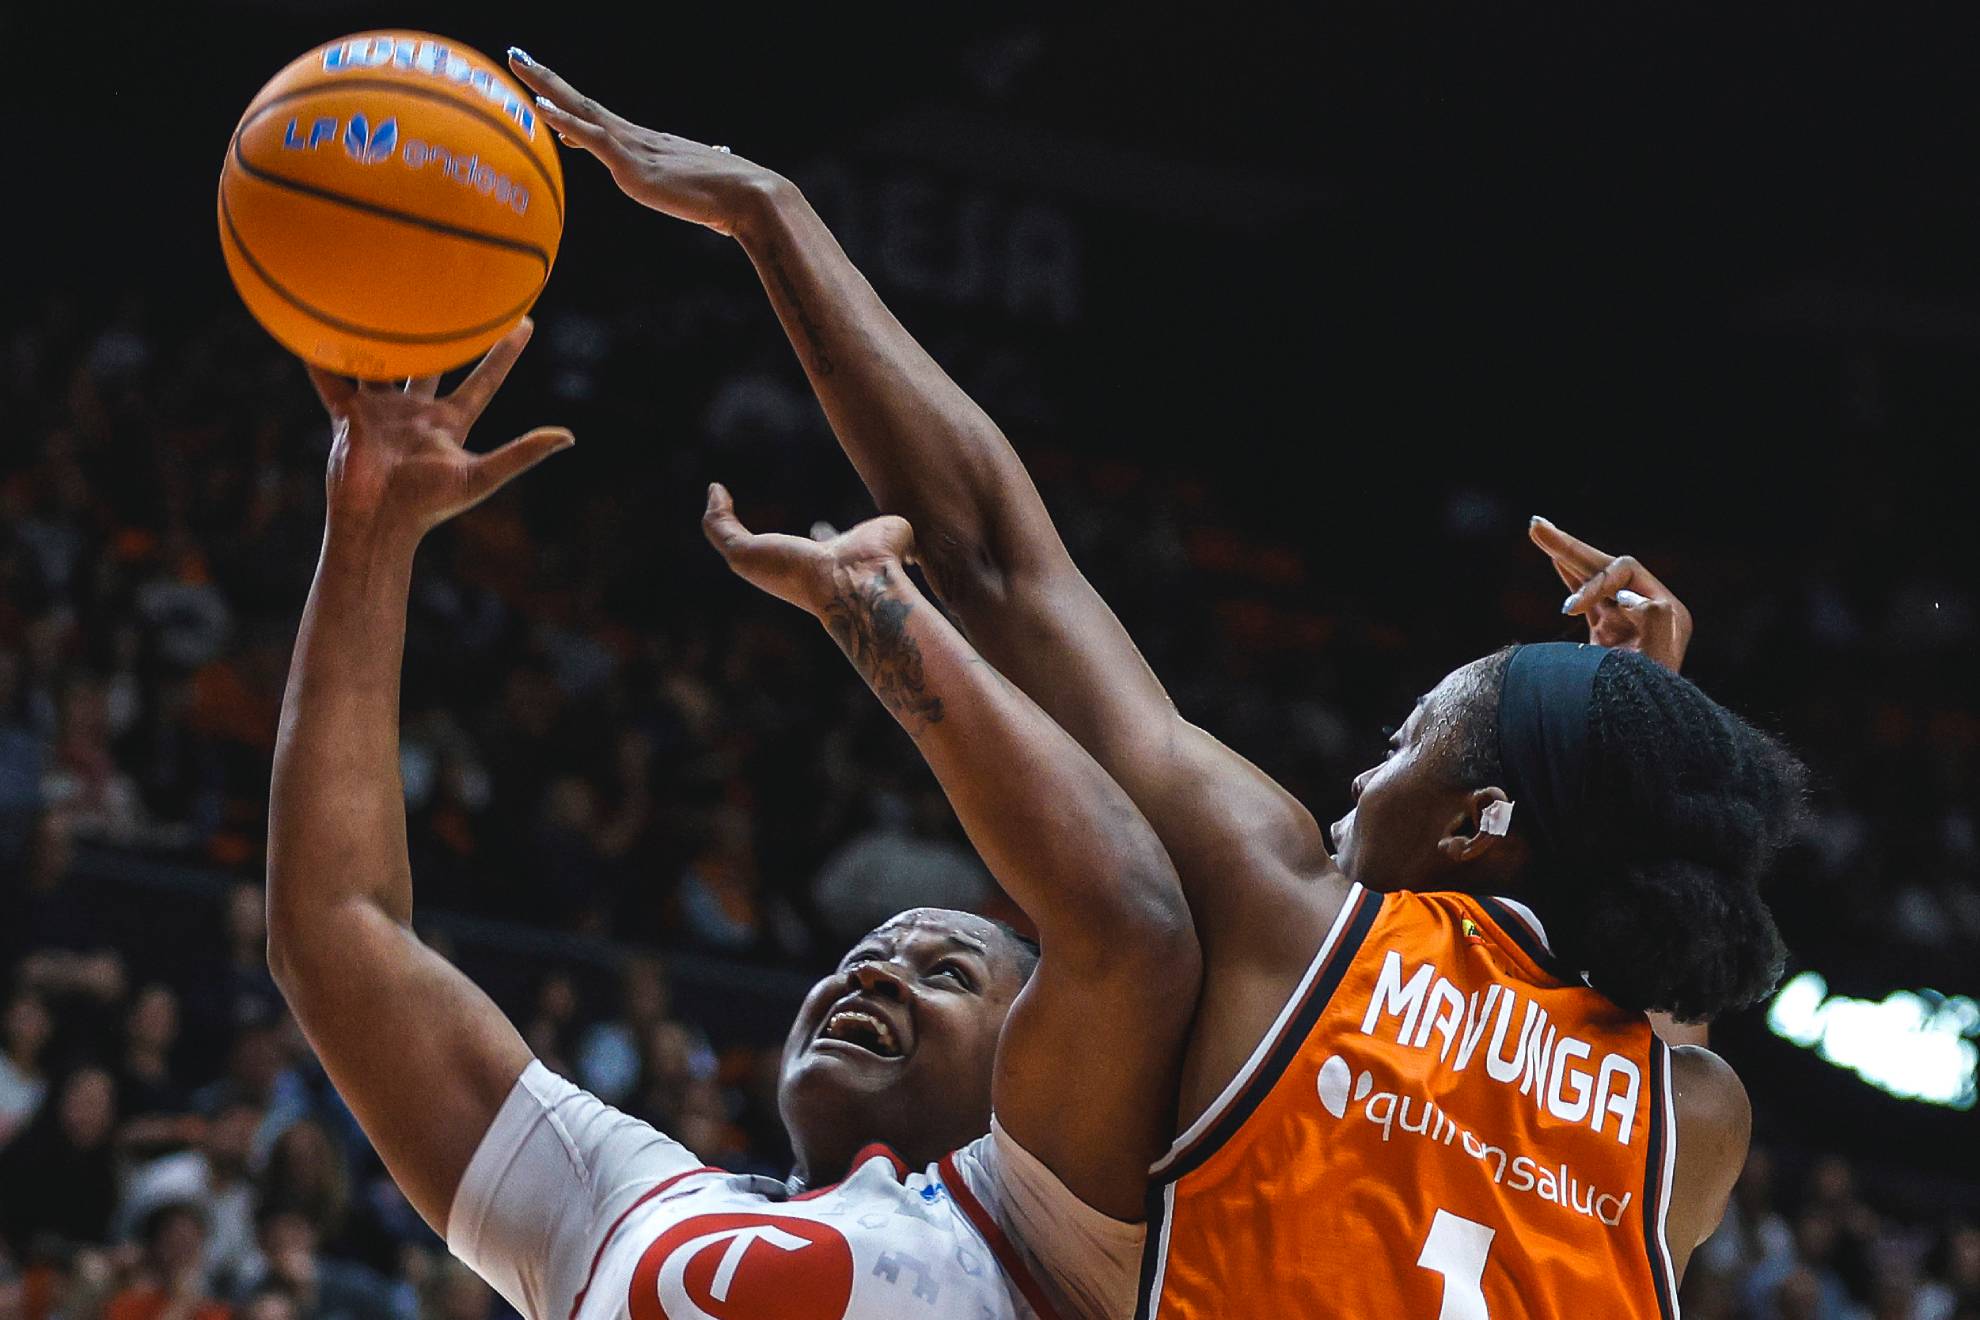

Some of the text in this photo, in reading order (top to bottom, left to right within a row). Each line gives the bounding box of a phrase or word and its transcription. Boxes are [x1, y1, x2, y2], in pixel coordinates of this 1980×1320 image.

[283, 116, 338, 152] LF
[1359, 950, 1641, 1146] MAVUNGA
[1416, 1207, 1496, 1320] 1
